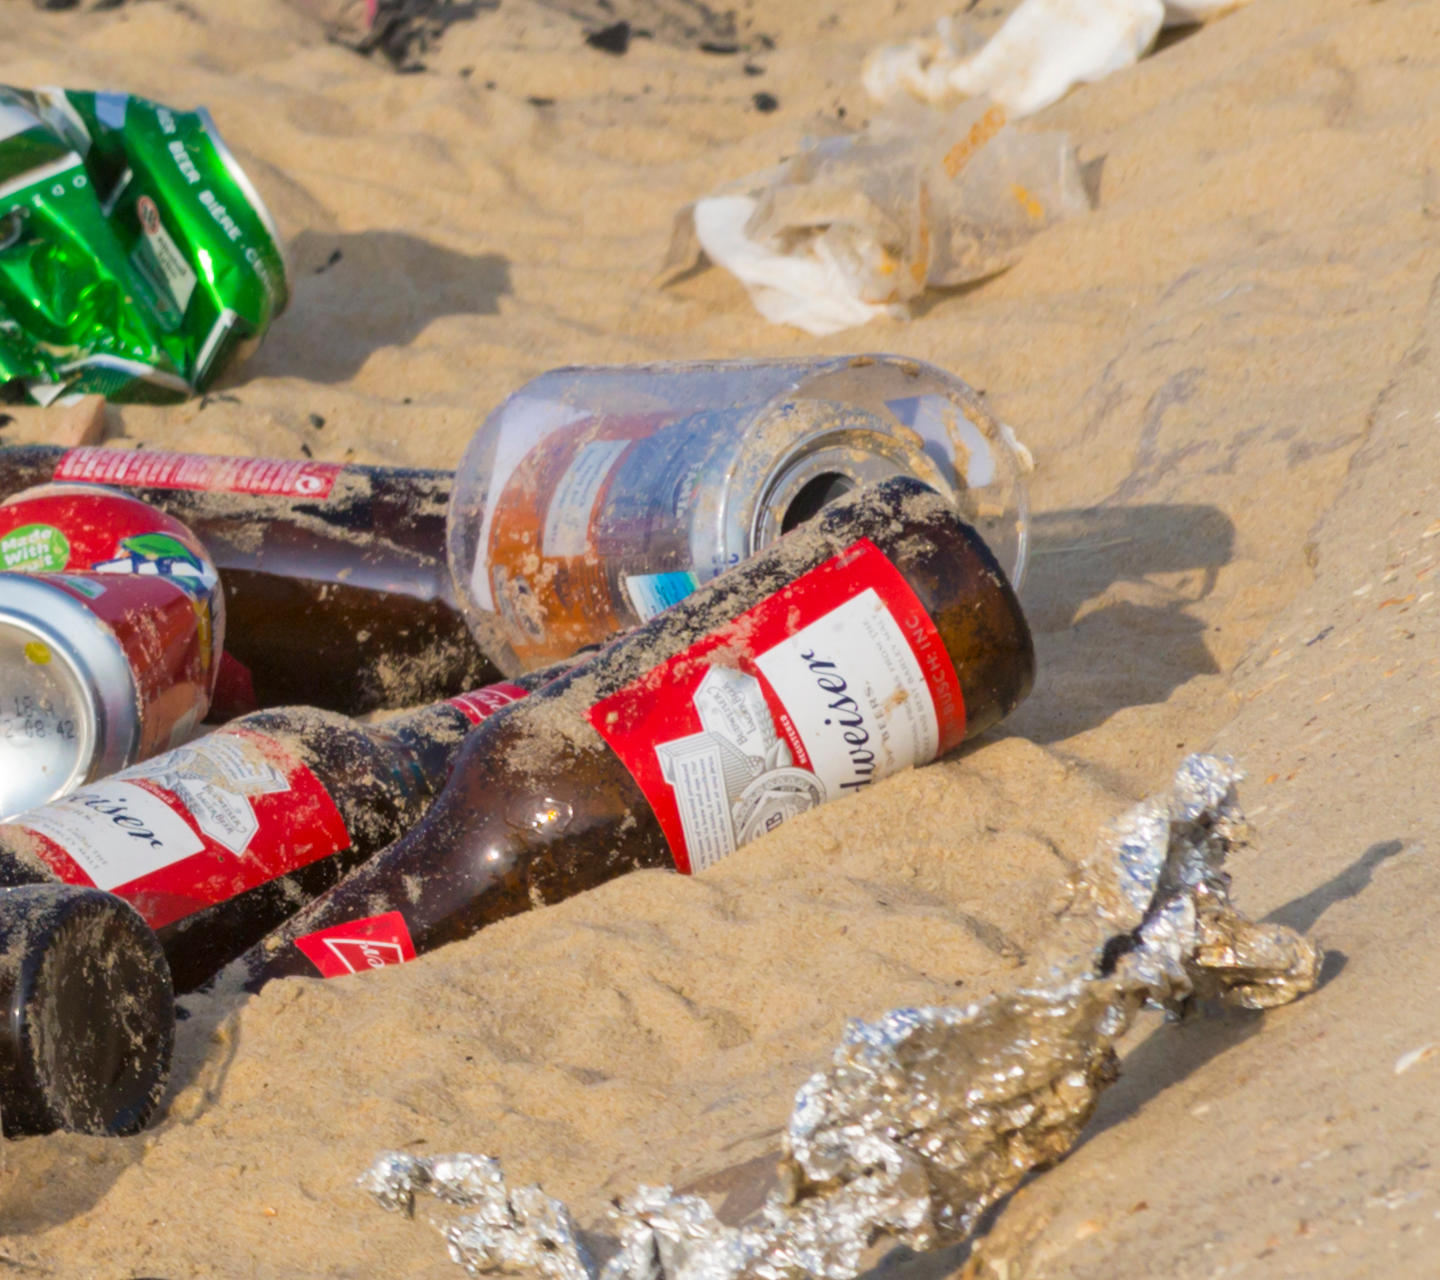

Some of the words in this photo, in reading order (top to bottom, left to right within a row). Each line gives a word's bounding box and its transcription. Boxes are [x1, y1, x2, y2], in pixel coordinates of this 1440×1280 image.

[166, 137, 202, 187] BEER
[0, 528, 52, 552] Made
[3, 543, 49, 566] With
[777, 712, 809, 764] REGISTERED
[796, 648, 876, 797] weiser
